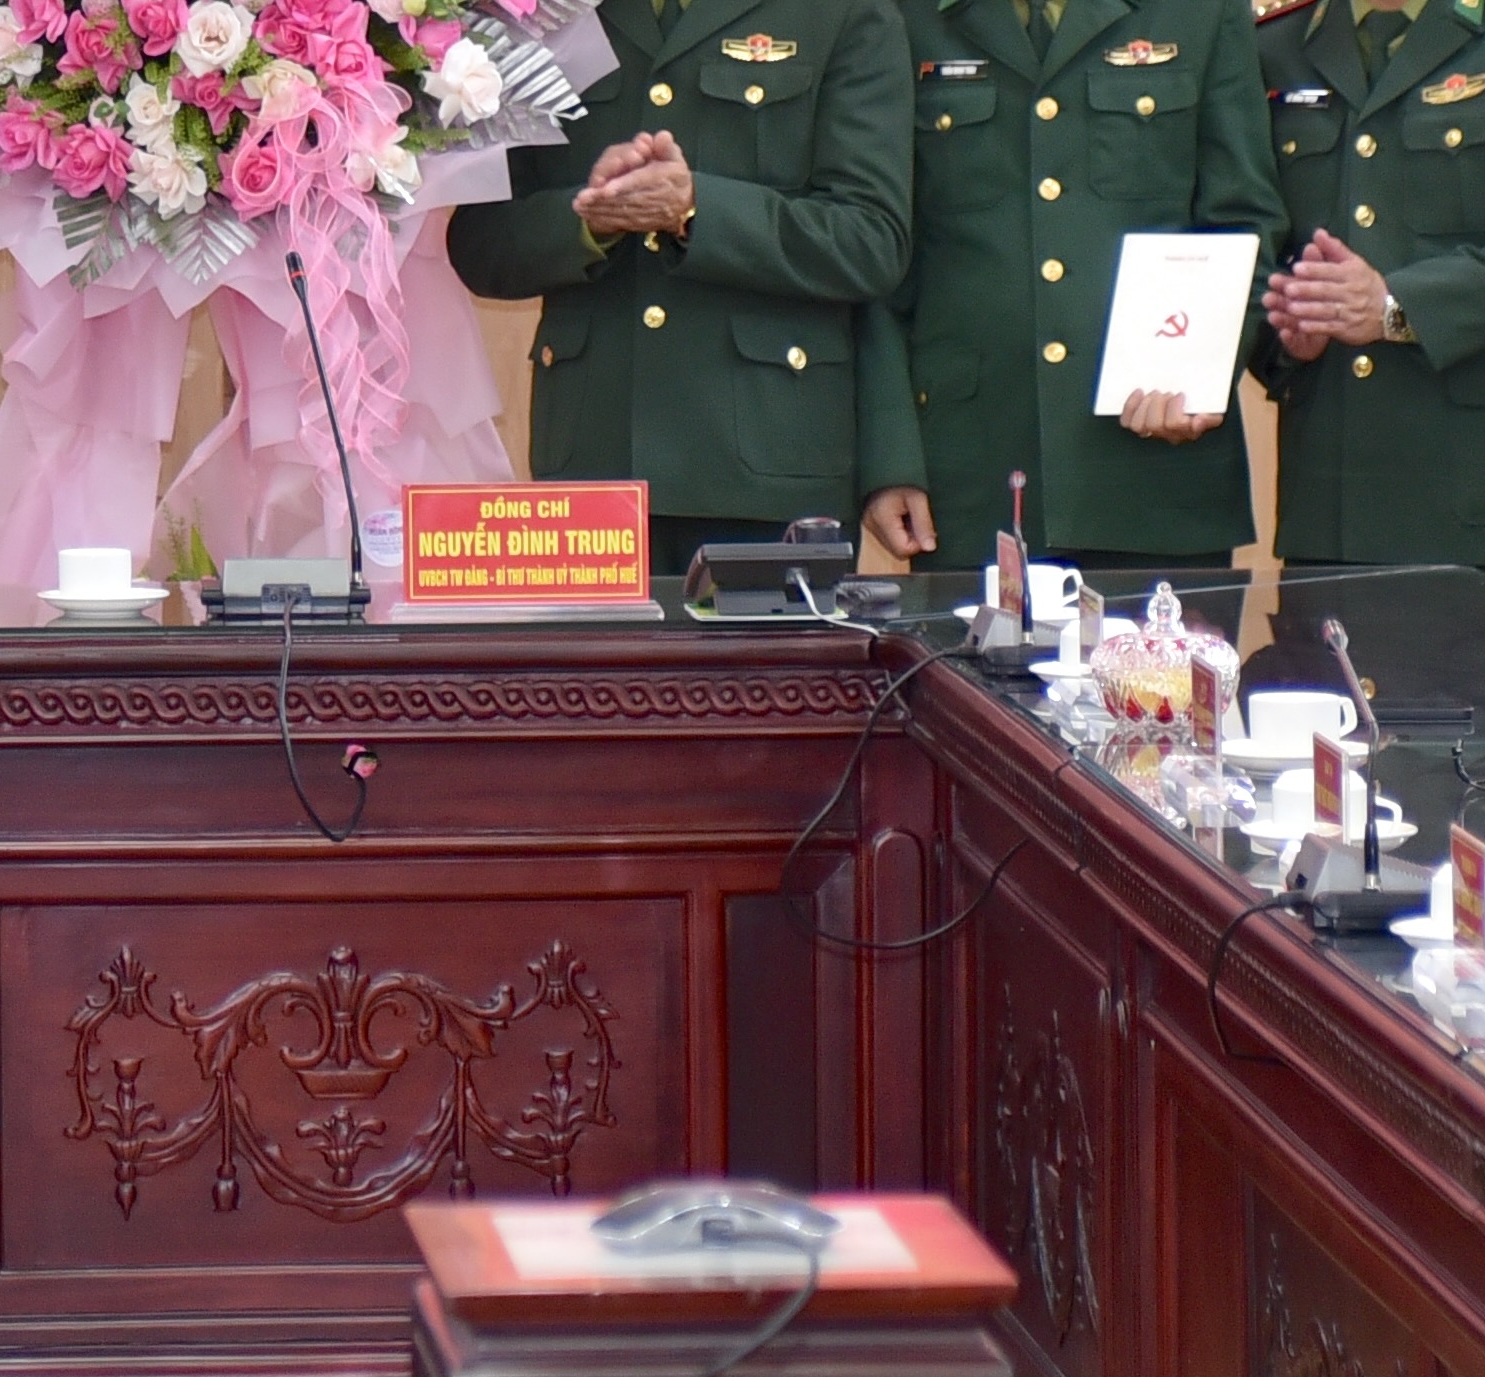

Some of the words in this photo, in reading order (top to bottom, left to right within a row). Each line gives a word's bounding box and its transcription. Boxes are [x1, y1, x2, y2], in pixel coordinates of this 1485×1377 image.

[479, 495, 532, 519] ĐỒNG
[537, 496, 571, 519] CHÍ
[418, 521, 502, 558] NGUYỄN
[506, 524, 559, 556] ĐÌNH
[564, 528, 636, 556] TRUNG
[526, 564, 555, 585] THÀNH
[569, 563, 598, 585] THÀNH
[599, 561, 618, 585] PHỐ
